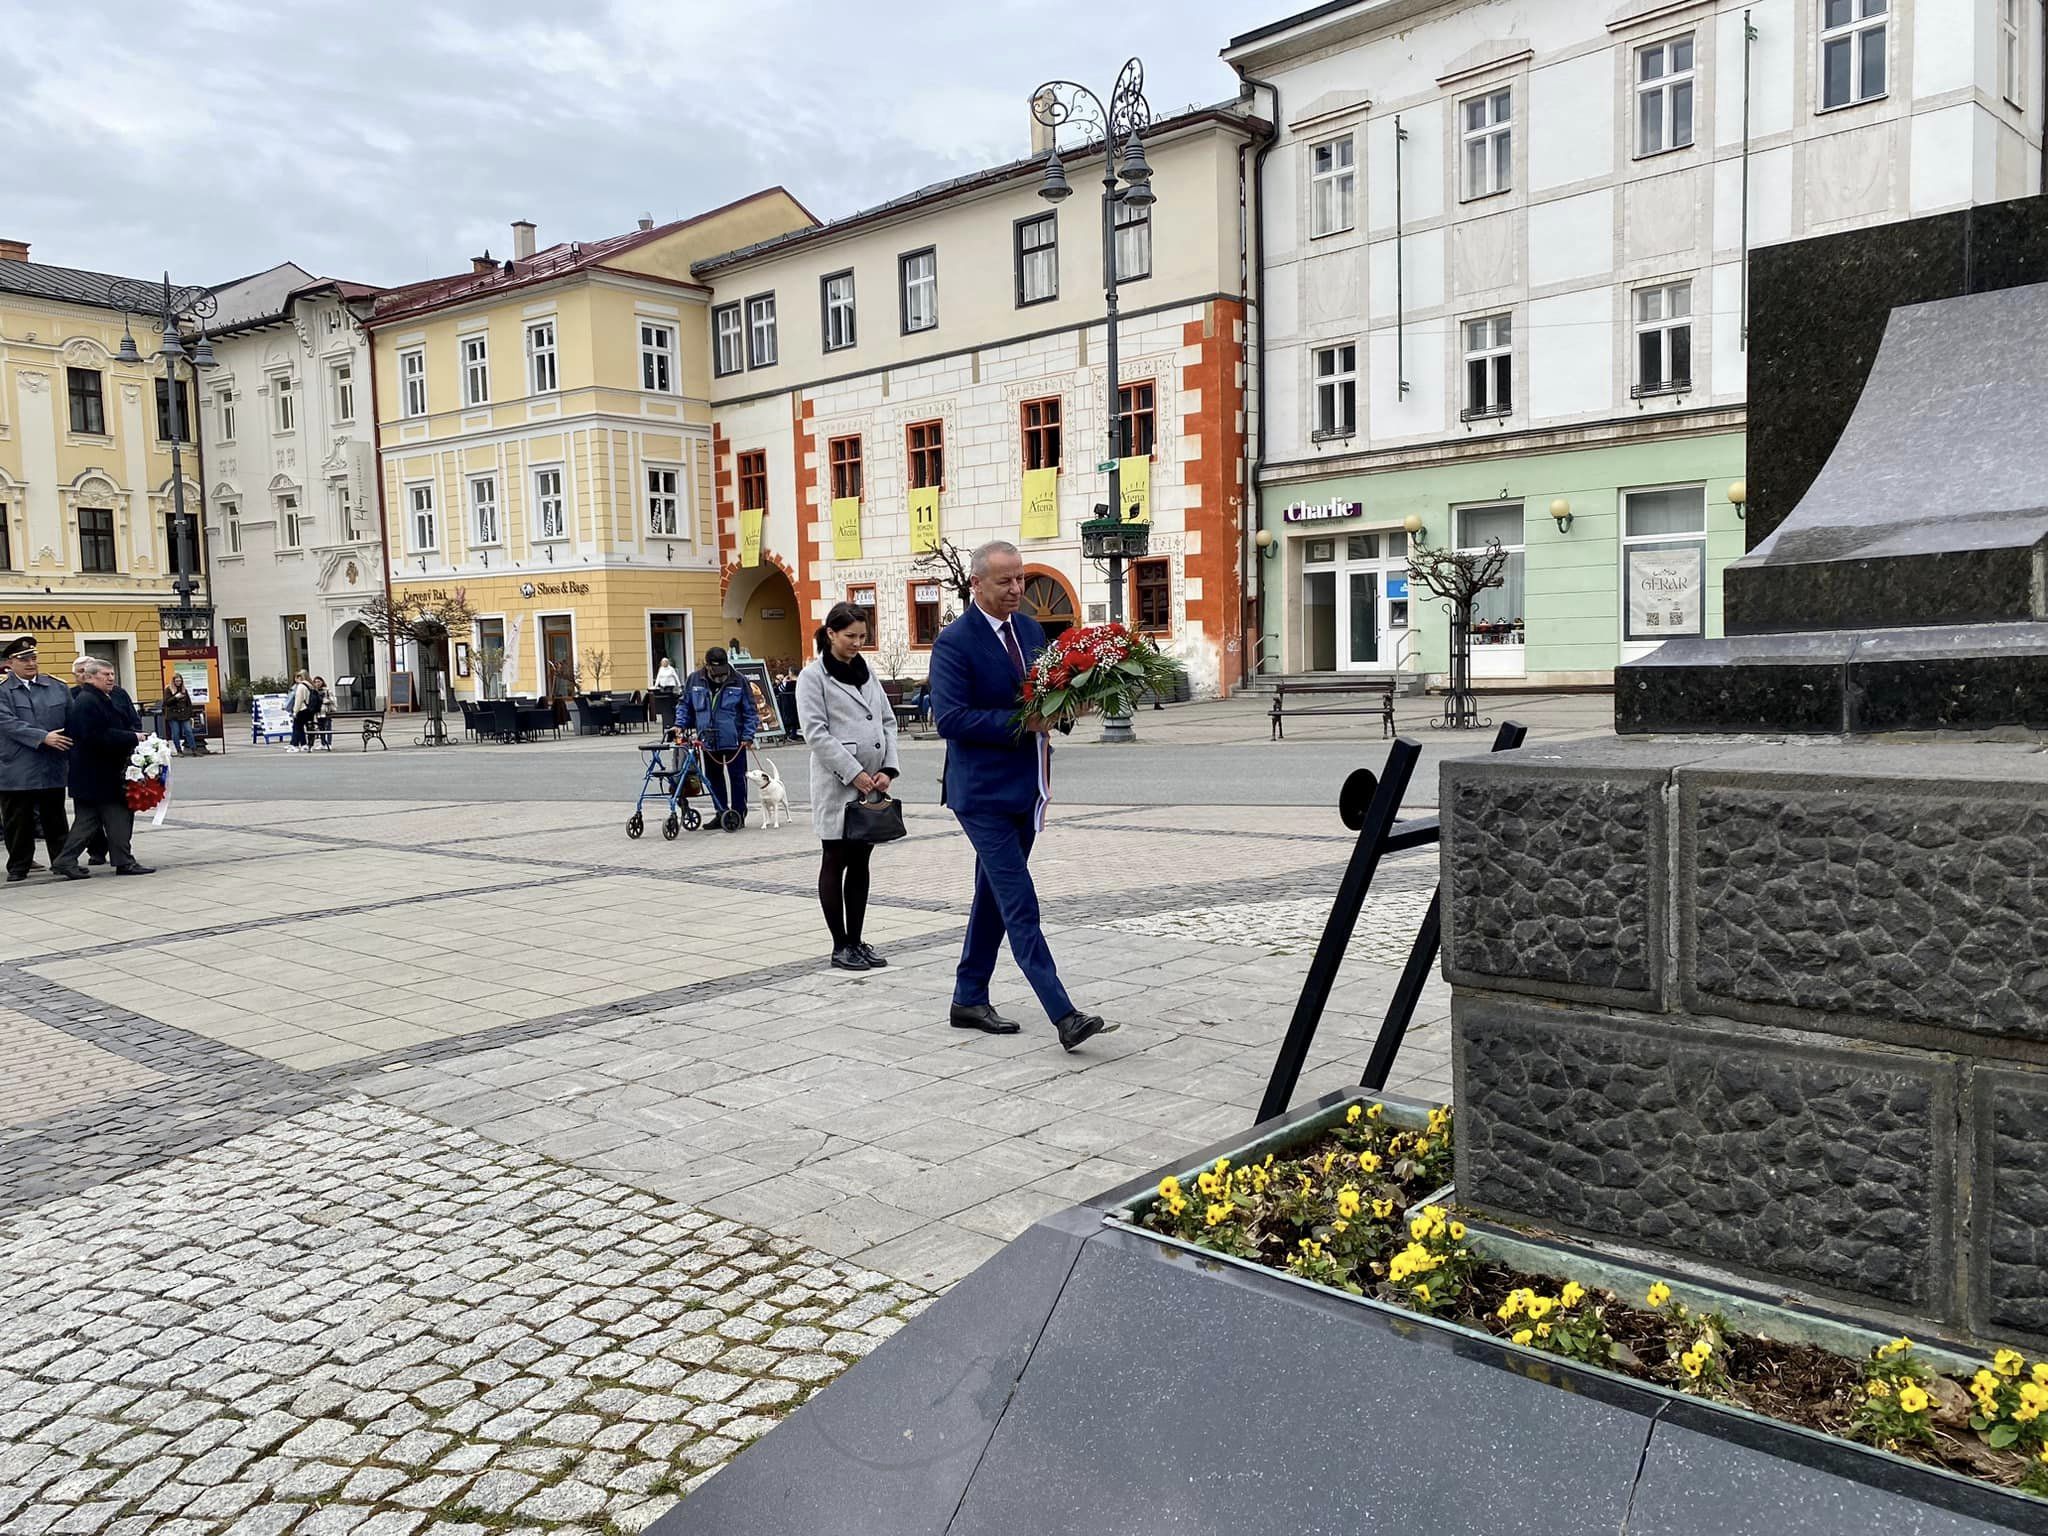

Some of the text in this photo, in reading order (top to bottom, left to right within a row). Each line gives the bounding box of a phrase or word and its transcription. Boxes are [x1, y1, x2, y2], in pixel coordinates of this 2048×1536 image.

[916, 505, 932, 523] 11
[1029, 500, 1054, 513] Atena
[1288, 497, 1353, 521] Charlie
[433, 588, 448, 601] Rak
[537, 580, 589, 595] Shoes & Bags
[0, 615, 72, 631] BANKA
